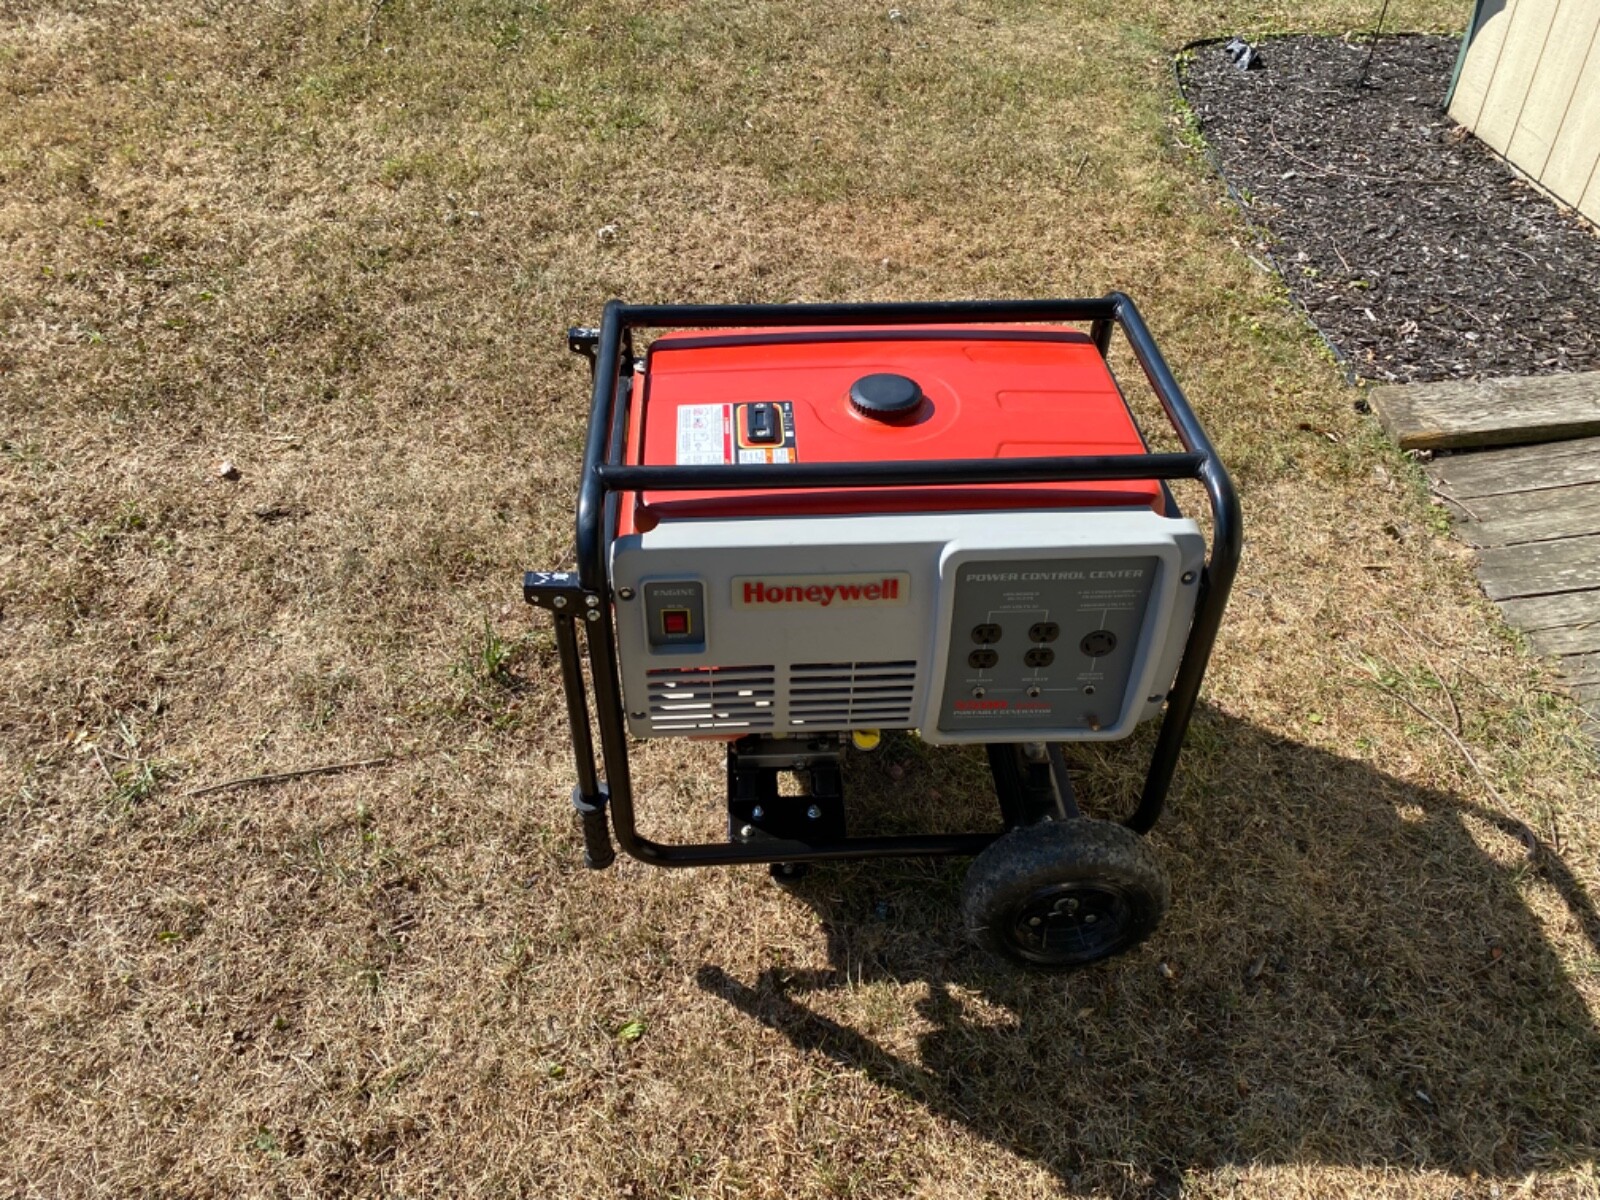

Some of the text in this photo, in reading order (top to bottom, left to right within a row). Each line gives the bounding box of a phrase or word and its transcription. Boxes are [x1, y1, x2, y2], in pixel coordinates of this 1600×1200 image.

[966, 569, 1144, 582] POWER CONTROL CENTER
[653, 589, 696, 597] ENGINE
[743, 579, 899, 607] Honeywell
